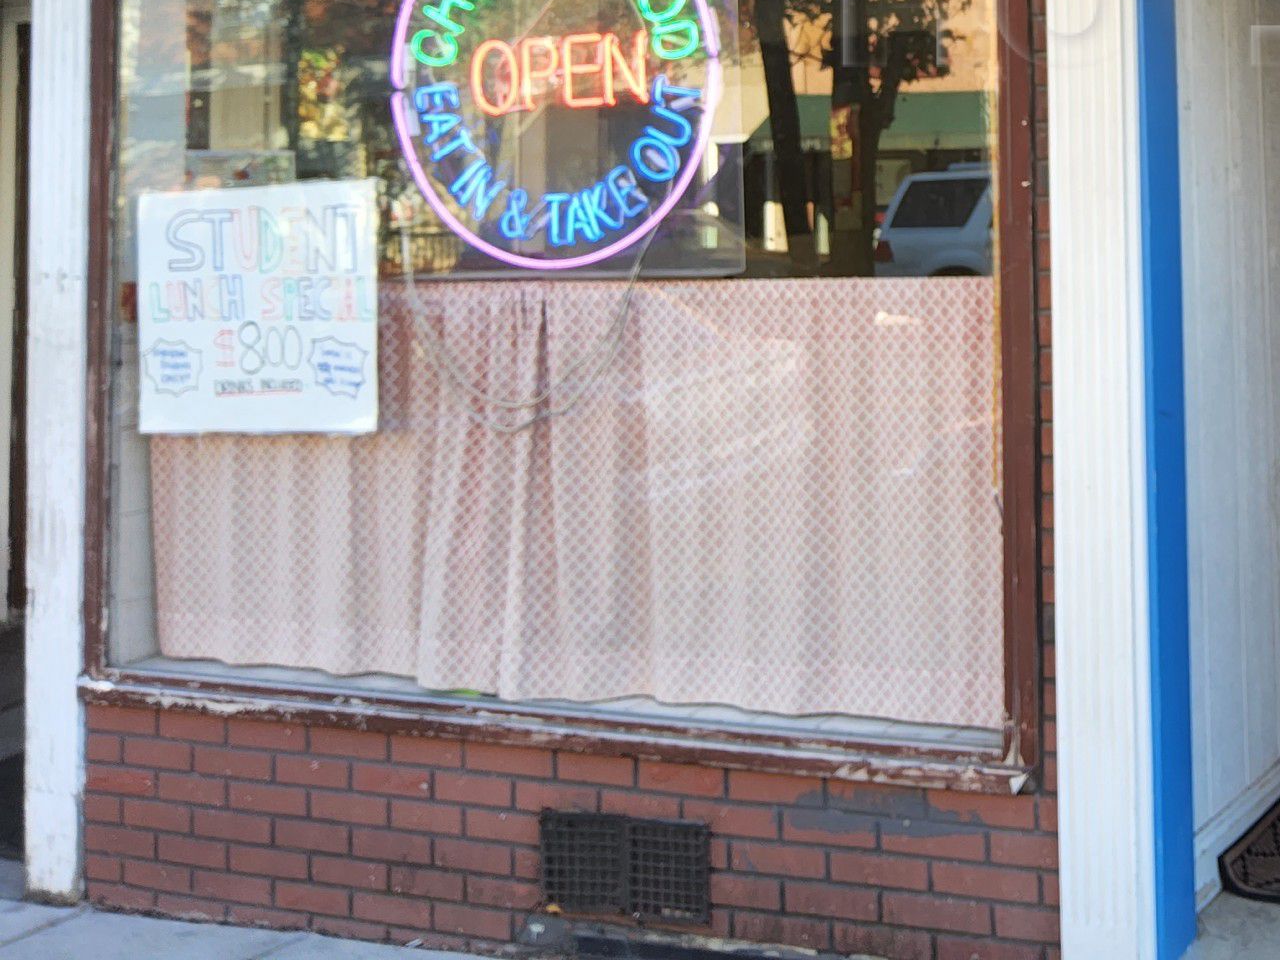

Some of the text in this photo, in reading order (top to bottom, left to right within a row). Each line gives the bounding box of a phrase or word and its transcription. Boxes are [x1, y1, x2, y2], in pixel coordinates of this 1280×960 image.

[470, 30, 650, 117] OPEN
[415, 74, 700, 247] EAT IN & TAKE OUT
[165, 202, 363, 275] STUDENT
